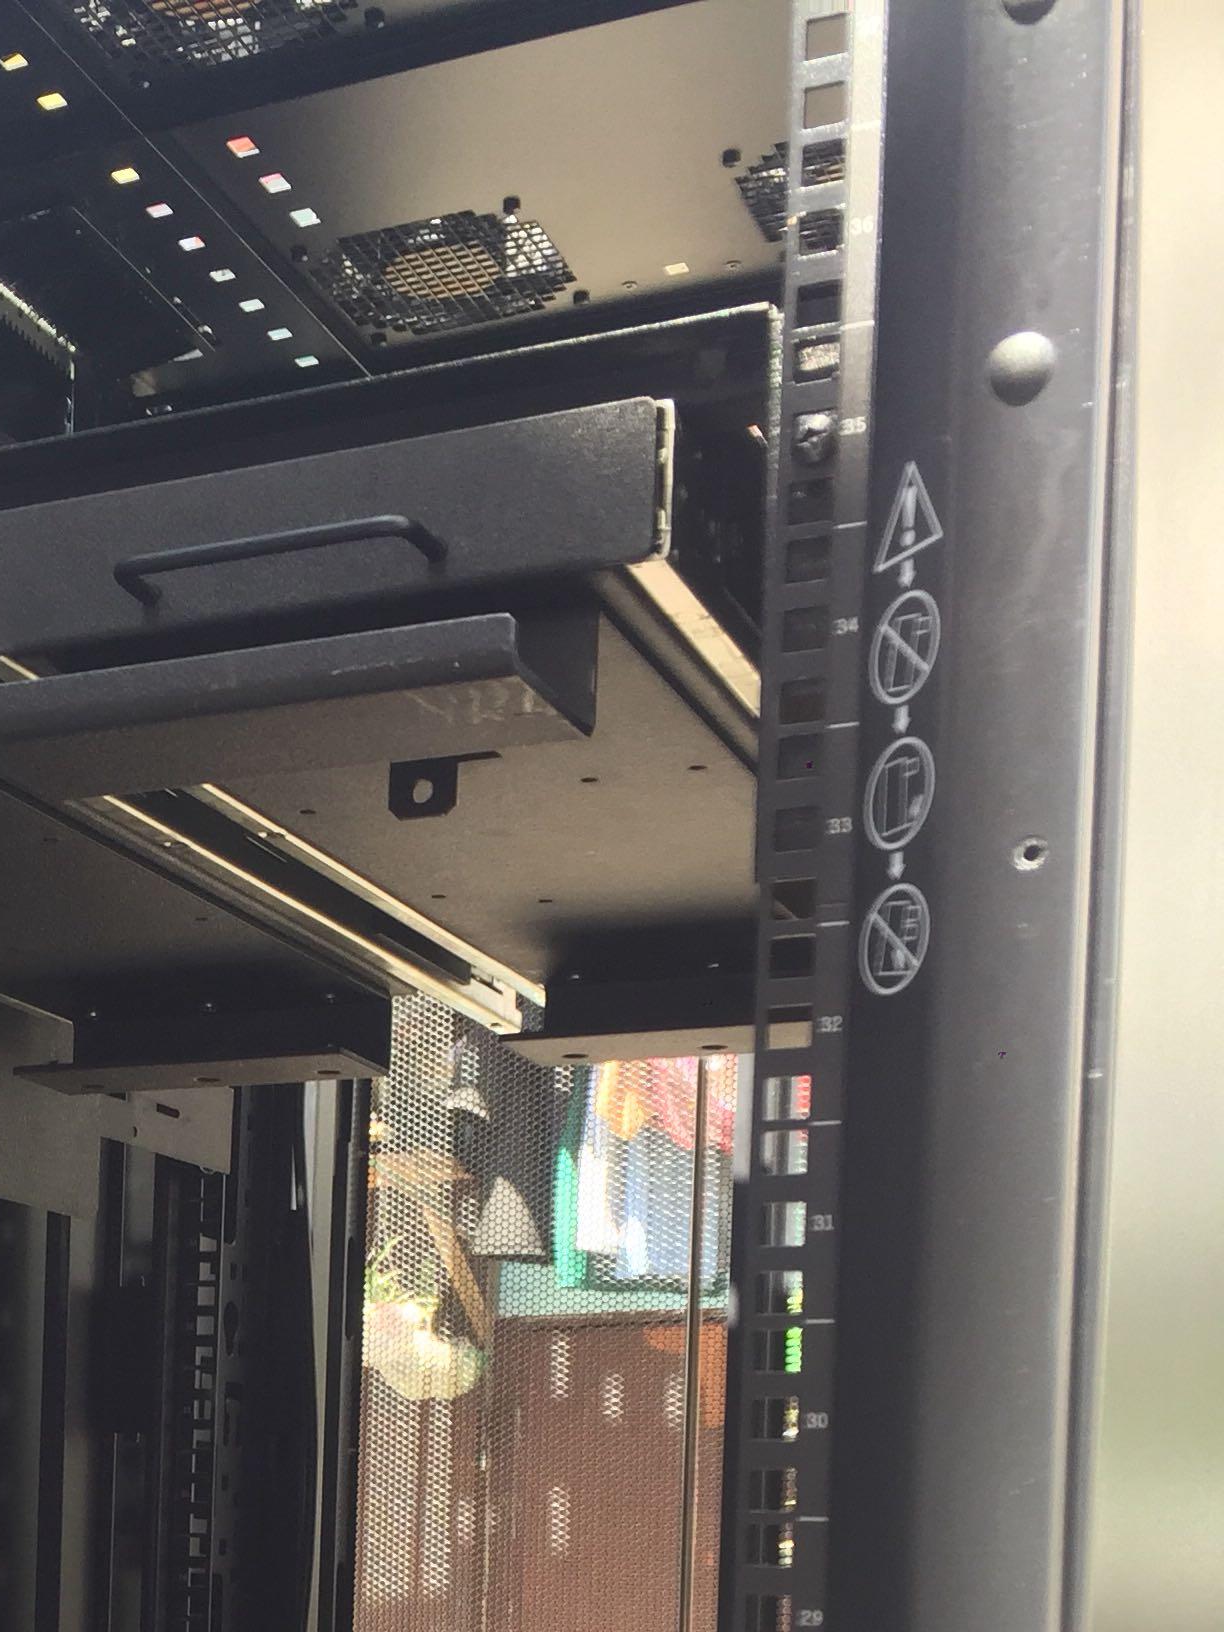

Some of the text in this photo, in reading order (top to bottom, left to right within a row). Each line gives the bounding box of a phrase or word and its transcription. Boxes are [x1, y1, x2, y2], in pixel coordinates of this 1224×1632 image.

[850, 216, 875, 236] 36
[840, 415, 867, 436] 35
[834, 616, 859, 635] 34
[828, 816, 853, 834] 33
[820, 1015, 843, 1034] 32
[811, 1214, 835, 1231] 31
[806, 1411, 829, 1429] 30
[800, 1609, 824, 1627] 29
